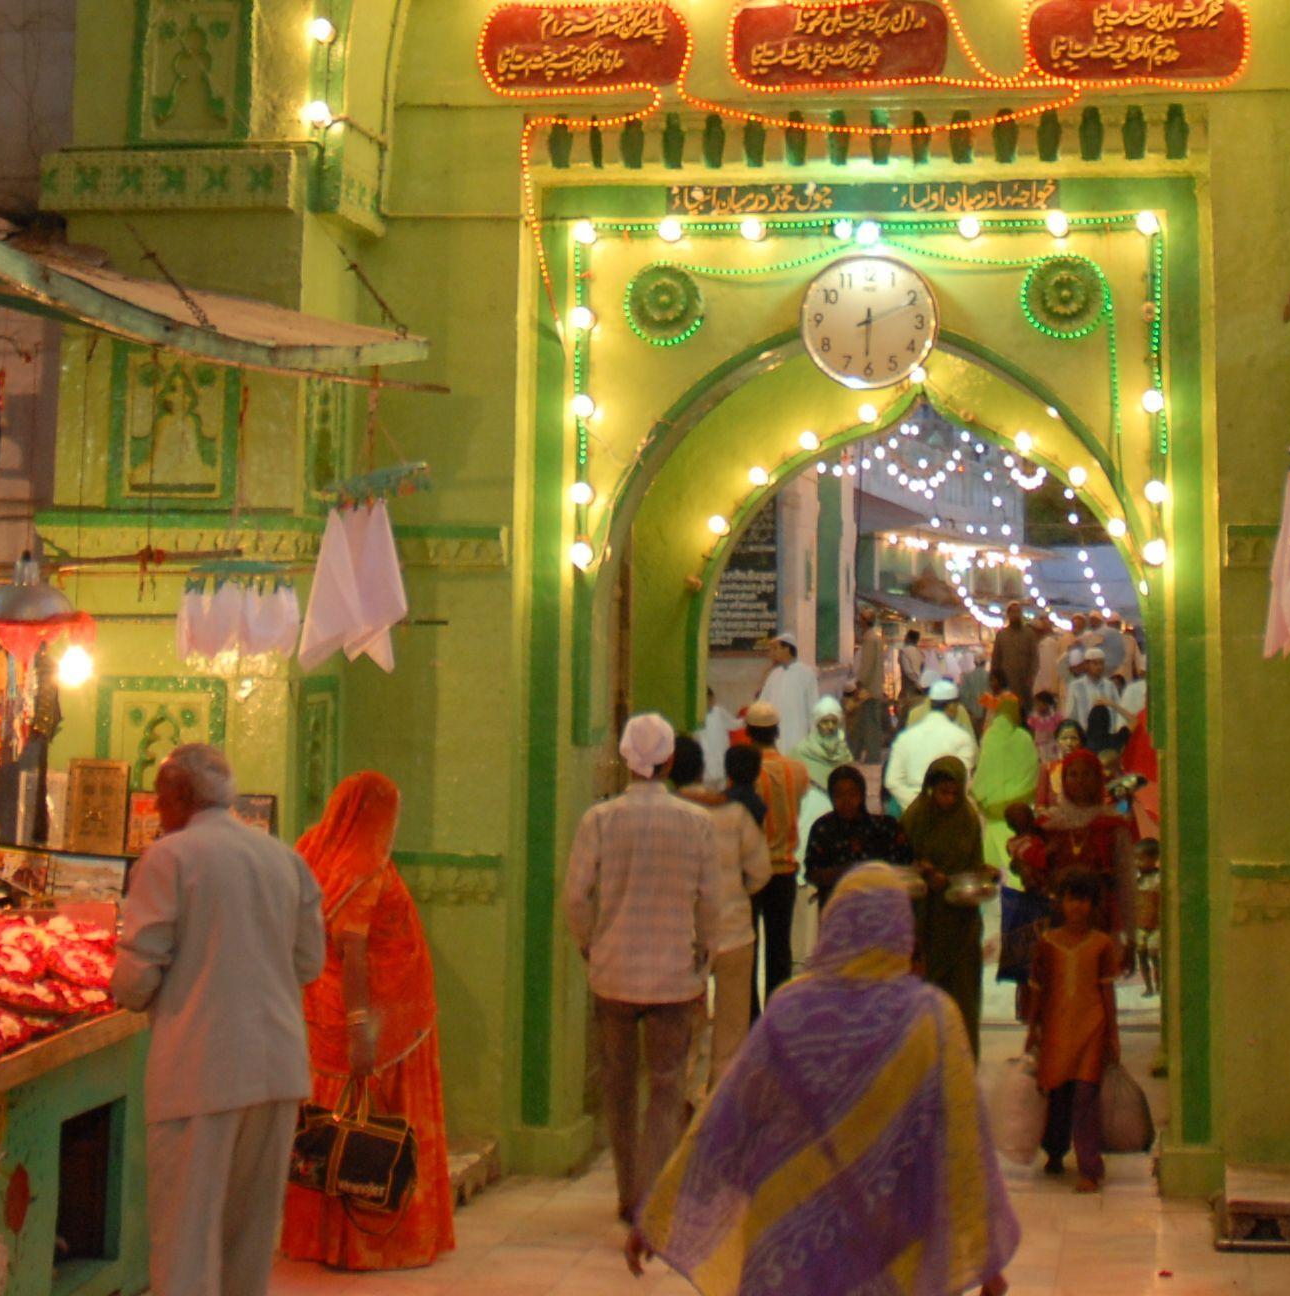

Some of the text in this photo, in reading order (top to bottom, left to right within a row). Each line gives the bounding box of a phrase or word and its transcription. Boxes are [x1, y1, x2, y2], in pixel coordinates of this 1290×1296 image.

[840, 273, 853, 289] 11
[890, 271, 896, 286] 1
[822, 289, 839, 304] 10
[907, 290, 918, 306] 2
[813, 313, 824, 328] 9
[914, 314, 925, 330] 3
[821, 337, 831, 352] 8
[906, 338, 916, 353] 4
[842, 355, 852, 371] 7
[863, 362, 874, 377] 6
[888, 355, 899, 372] 5
